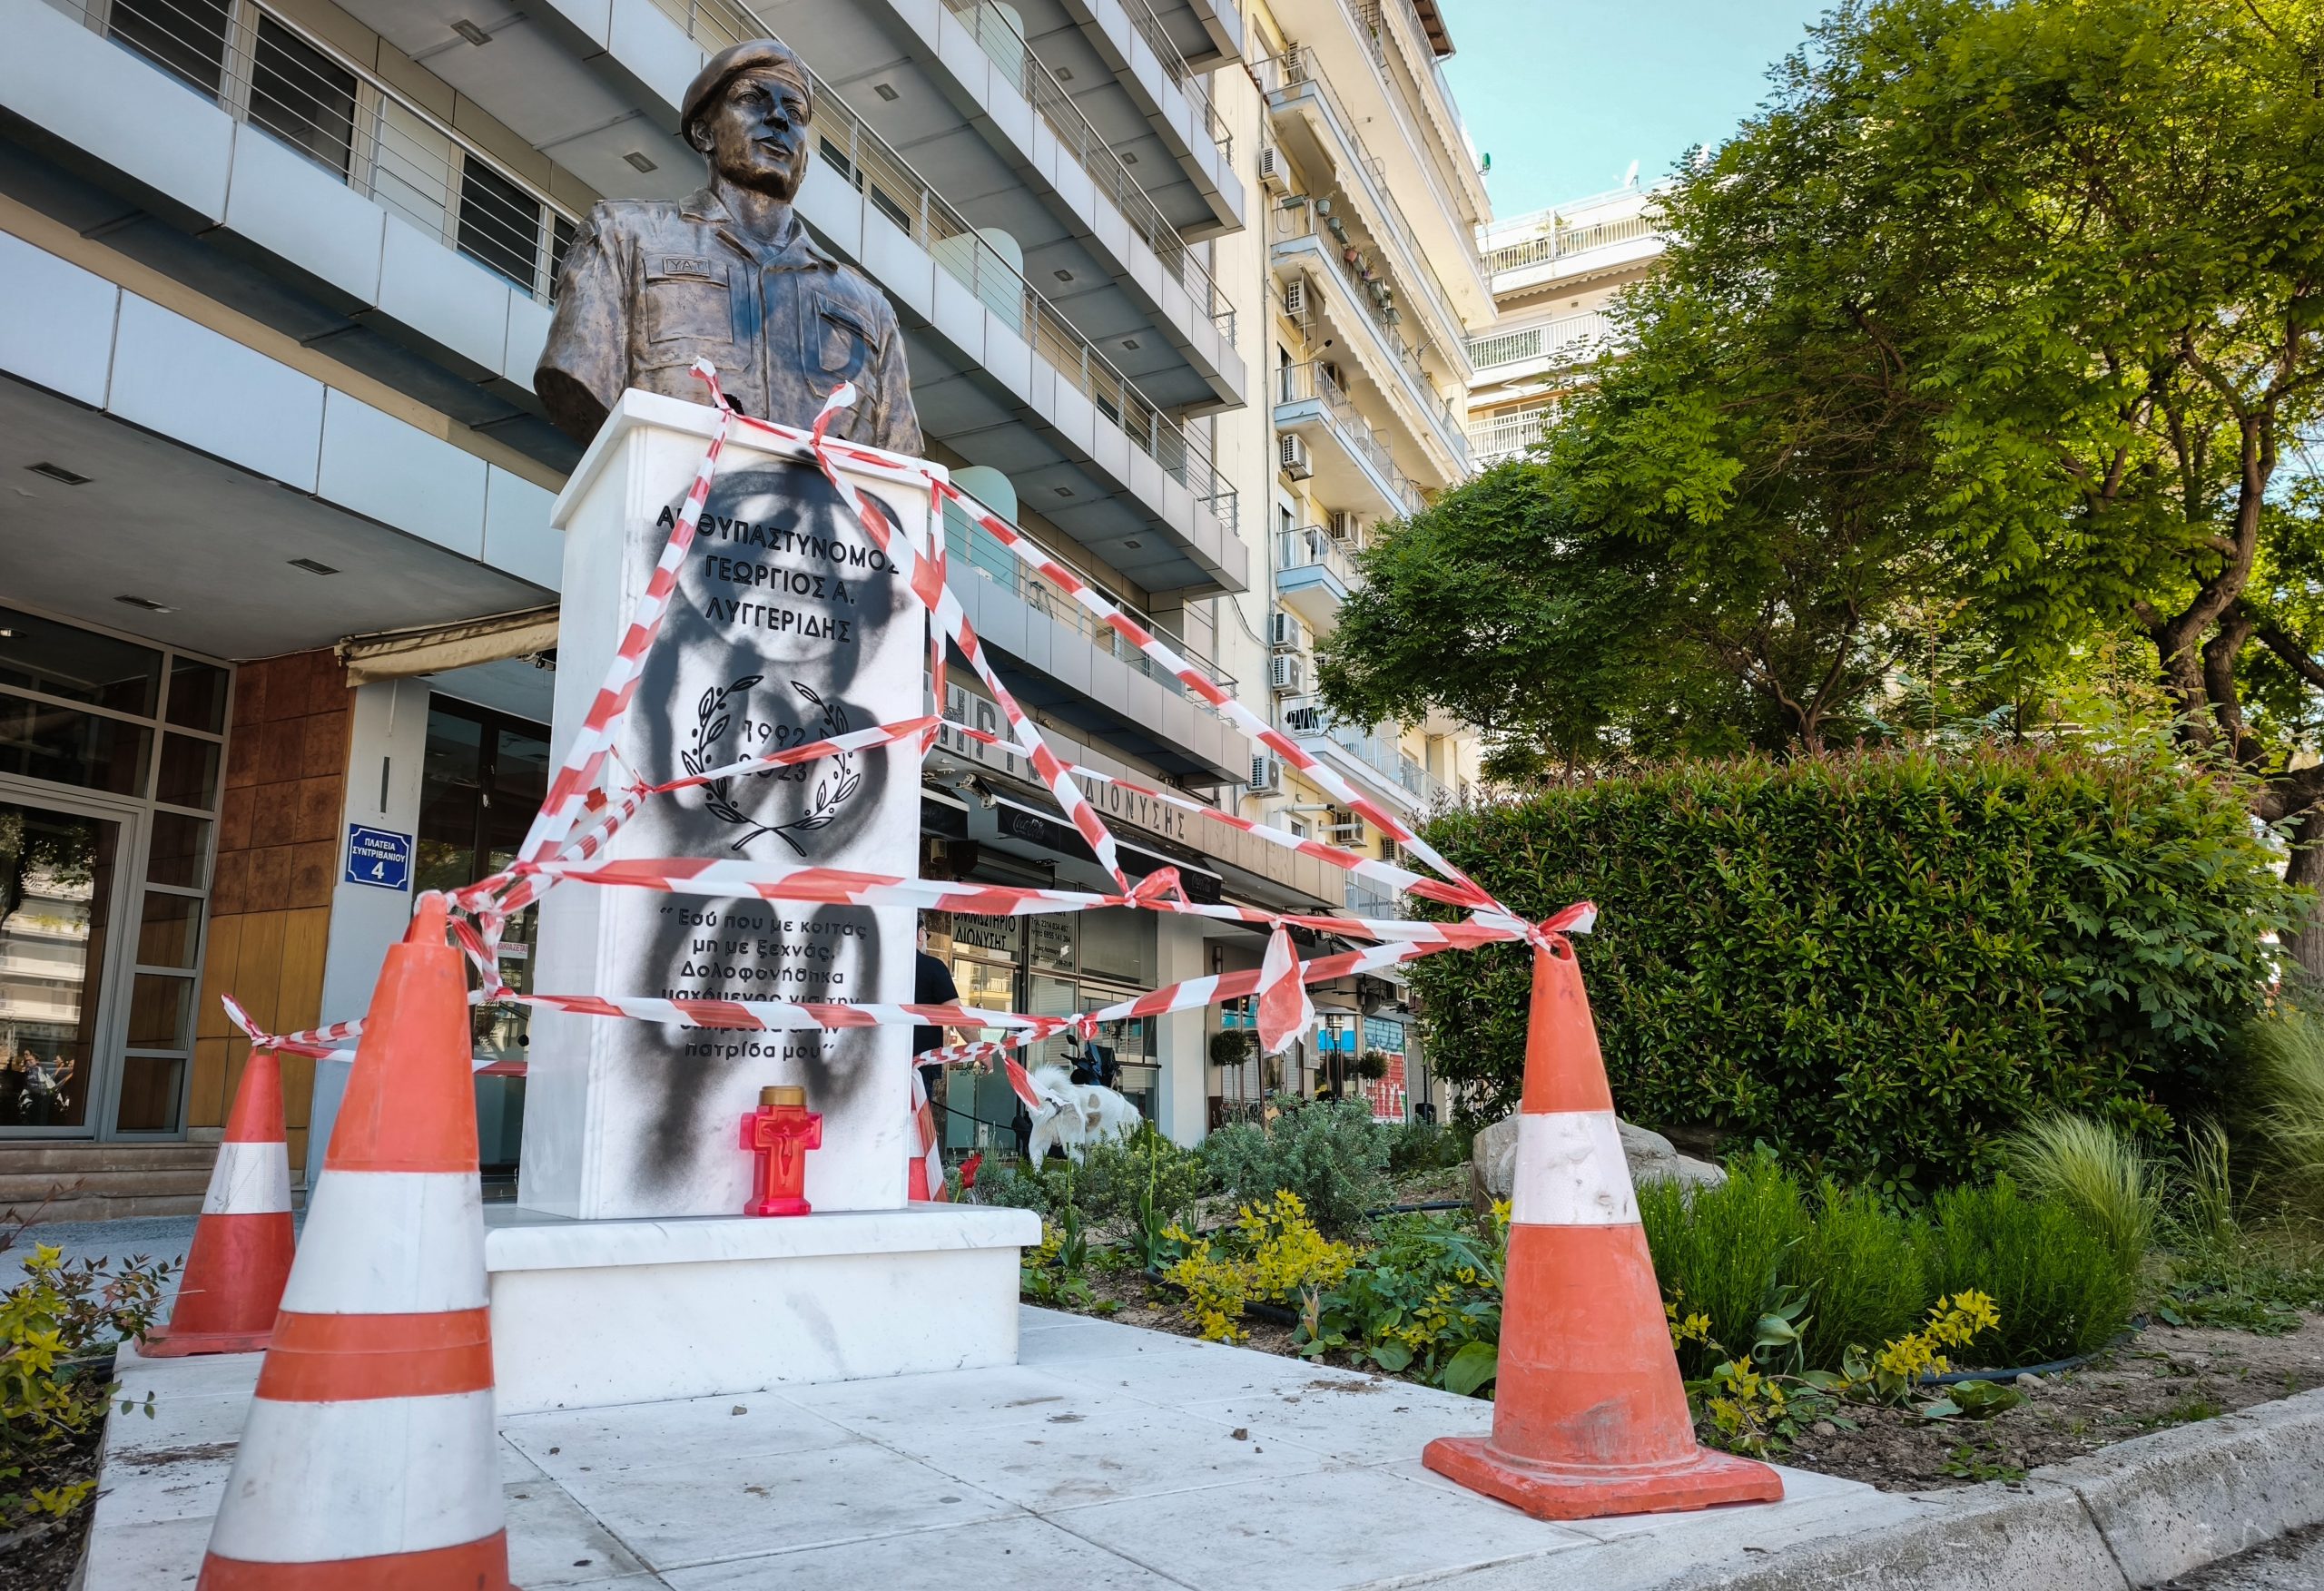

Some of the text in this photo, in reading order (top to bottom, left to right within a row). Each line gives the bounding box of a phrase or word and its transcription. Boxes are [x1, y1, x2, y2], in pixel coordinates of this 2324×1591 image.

[656, 505, 900, 575] ΑΘΥΠΑΣΤΥΝΟΜΟ
[705, 555, 855, 604] ΓΕΩΡΓΙΟΣ Α.
[705, 596, 851, 643] ΛΥΓΓΕΡΙΔΗΣ
[744, 720, 806, 748] 1992
[1085, 777, 1185, 840] ΔΙΟΝΥΣΗΣ
[352, 846, 406, 863] ΣΥΝΤΡΙΒΑΝΙΟΥ
[364, 838, 396, 851] ΠΛΑΤΕΙΑ
[371, 861, 385, 879] 4
[724, 916, 763, 930] που
[770, 918, 793, 933] με
[800, 920, 868, 939] κοιτάς
[956, 926, 1006, 950] ΔΙΟΝΥΣΗΣ
[693, 938, 718, 955] μη
[725, 940, 749, 957] με
[680, 960, 844, 984] Δολοφονήθηκα
[684, 1041, 775, 1060] πατρίδα
